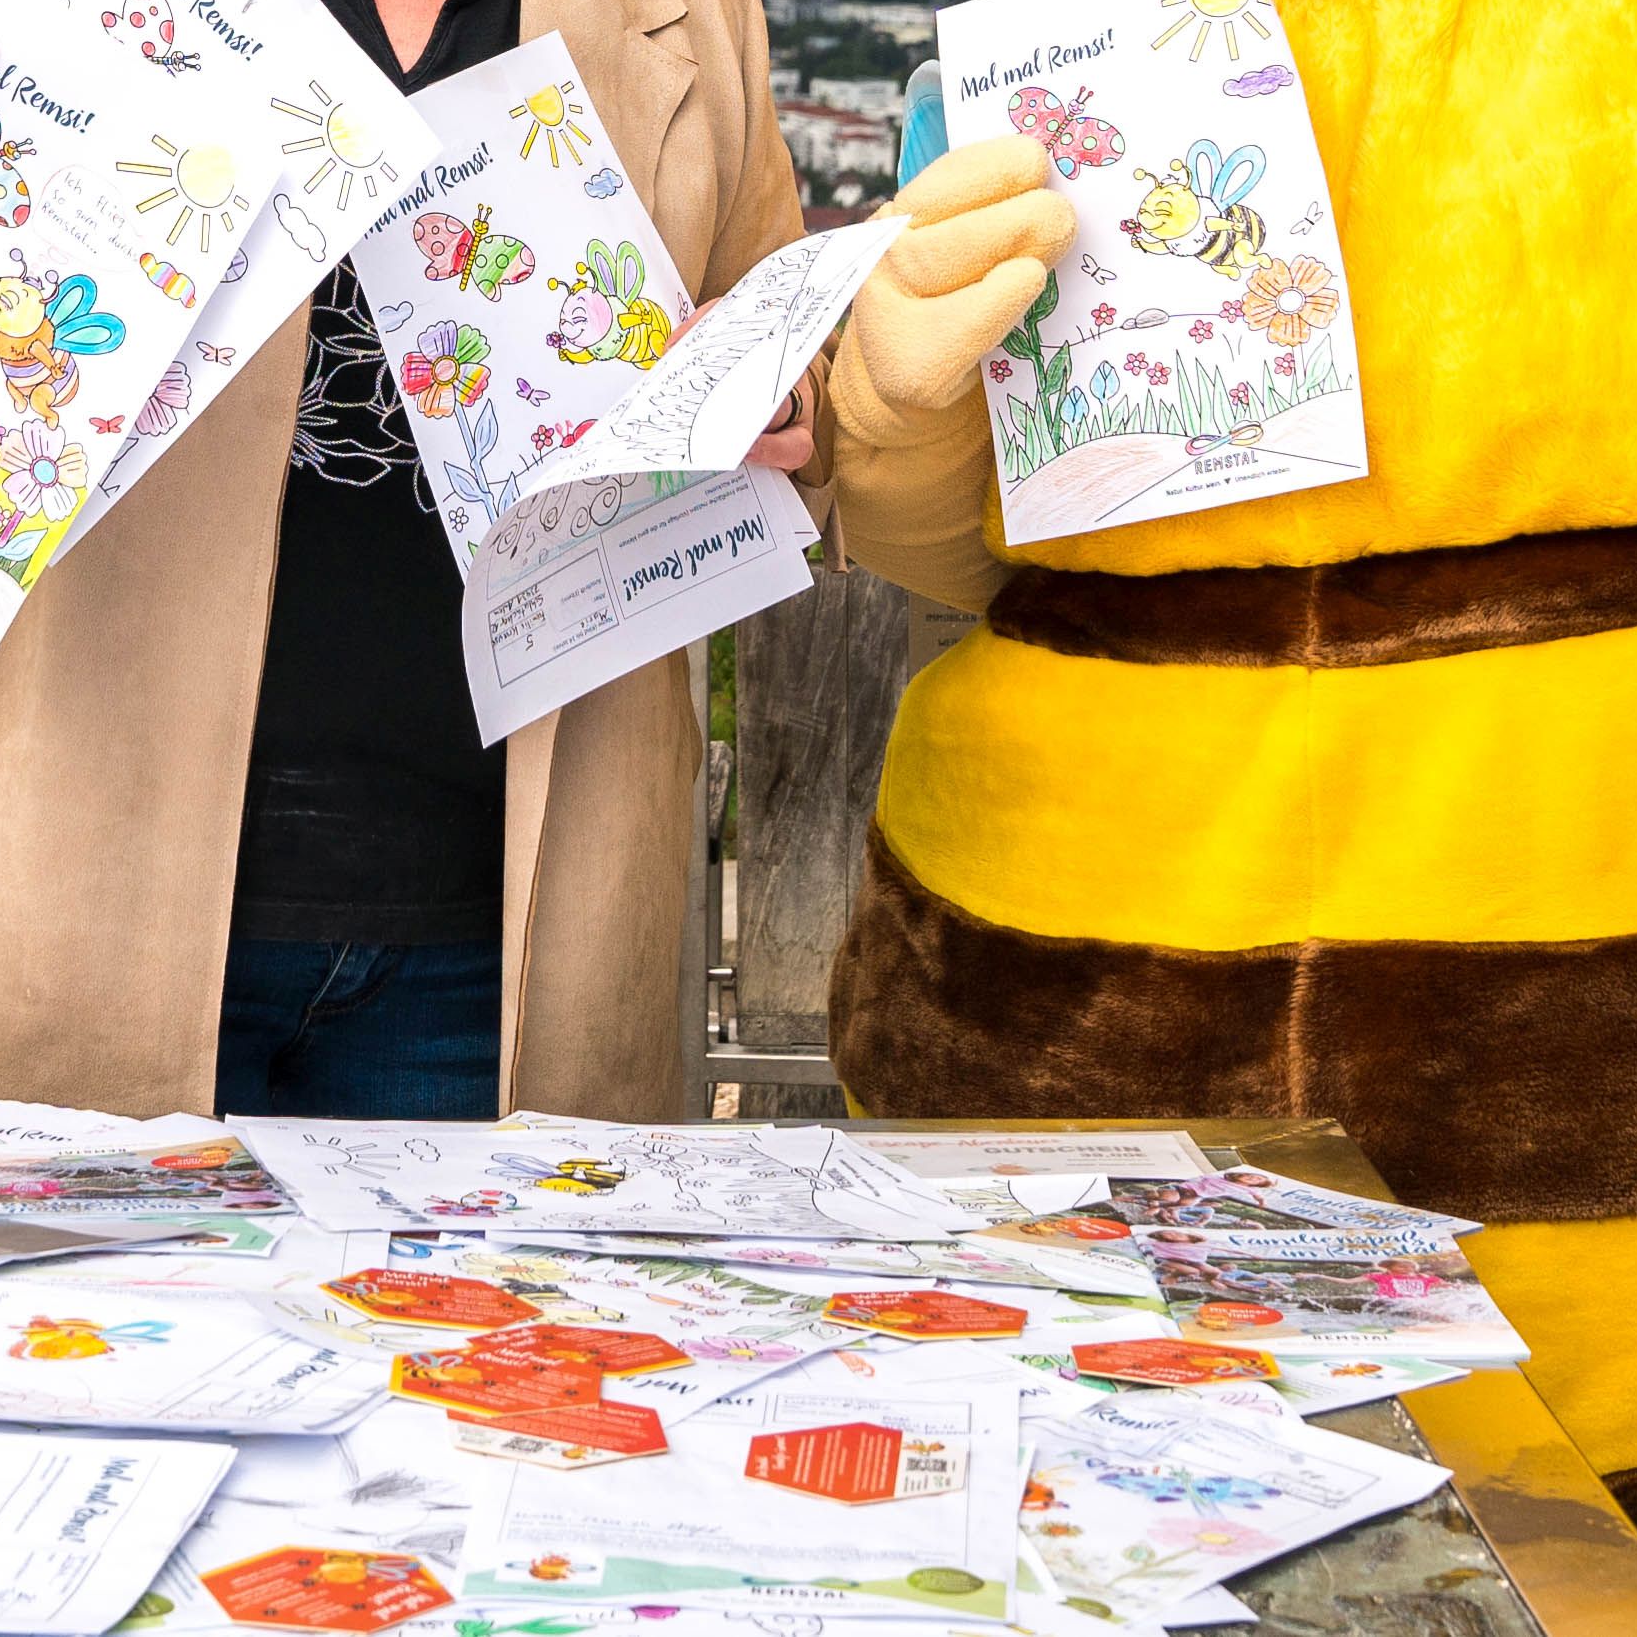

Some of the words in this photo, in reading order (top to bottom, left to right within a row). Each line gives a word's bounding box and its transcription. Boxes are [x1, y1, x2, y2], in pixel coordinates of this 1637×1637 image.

[961, 62, 999, 102] Mal
[1004, 47, 1042, 86] mal
[1048, 28, 1114, 74] Remsi!
[11, 76, 95, 134] Remsi!
[64, 172, 82, 195] Ich
[399, 171, 435, 216] mal
[434, 142, 494, 197] Remsi!
[1194, 450, 1259, 475] REMSTAL
[729, 513, 765, 558] Mal
[685, 535, 723, 571] mal
[623, 550, 684, 602] Remsi!
[525, 634, 534, 651] 5
[984, 1145, 1141, 1154] GUTSCHEIN
[1229, 1230, 1426, 1247] Familienspaß
[1326, 1242, 1443, 1258] Remstal
